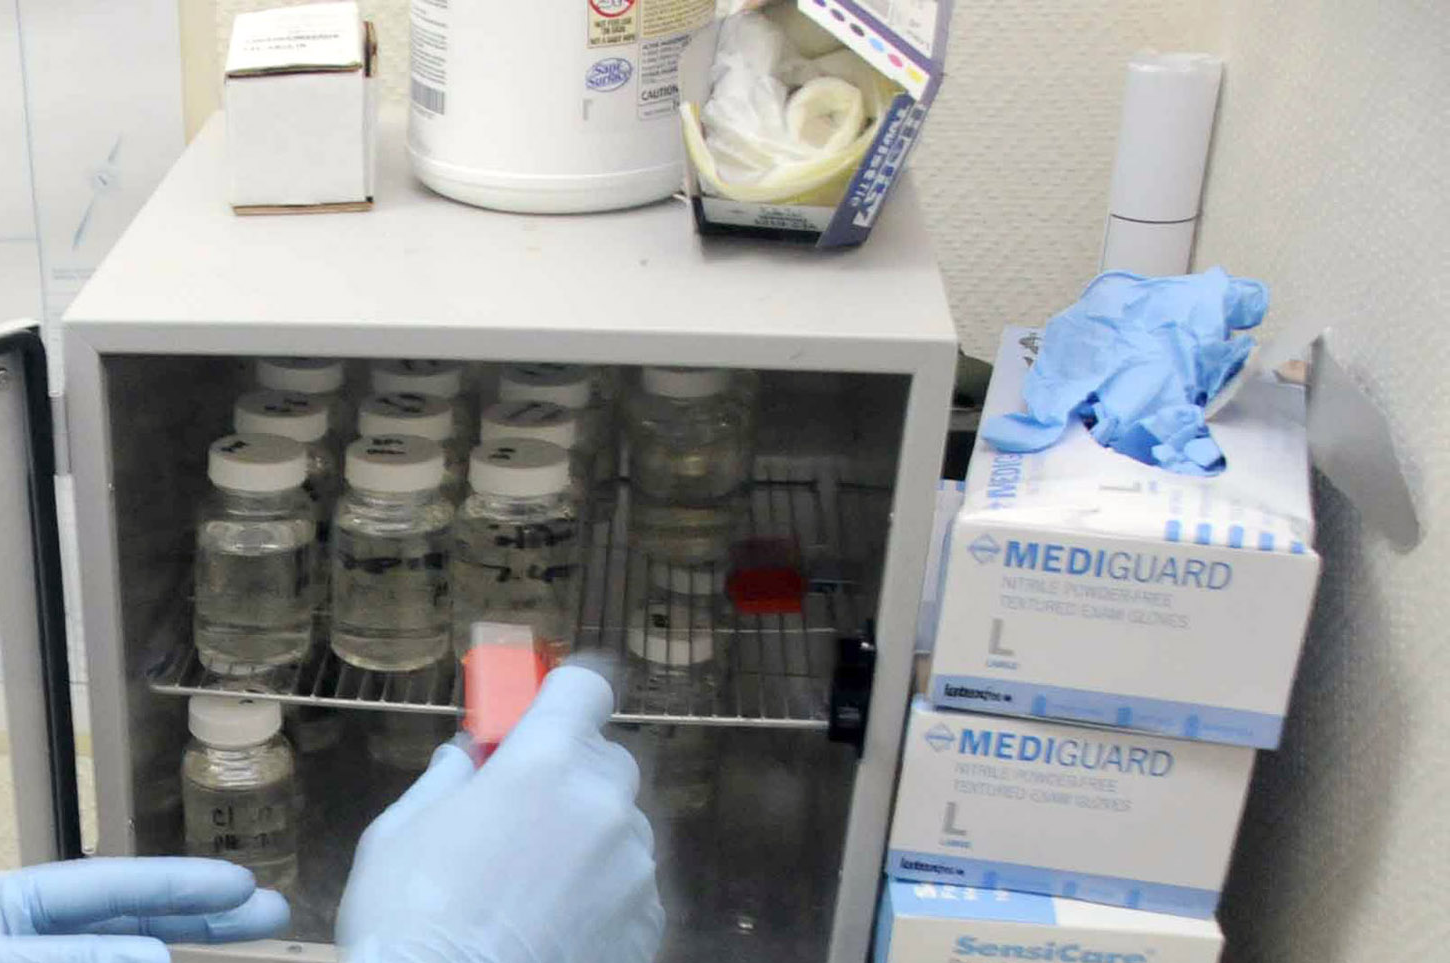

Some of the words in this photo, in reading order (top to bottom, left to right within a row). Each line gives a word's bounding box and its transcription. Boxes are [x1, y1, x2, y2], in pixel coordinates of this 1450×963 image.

[1003, 540, 1233, 590] MEDIGUARD
[988, 618, 1015, 656] L
[958, 728, 1175, 777] MEDIGUARD
[941, 801, 967, 836] L
